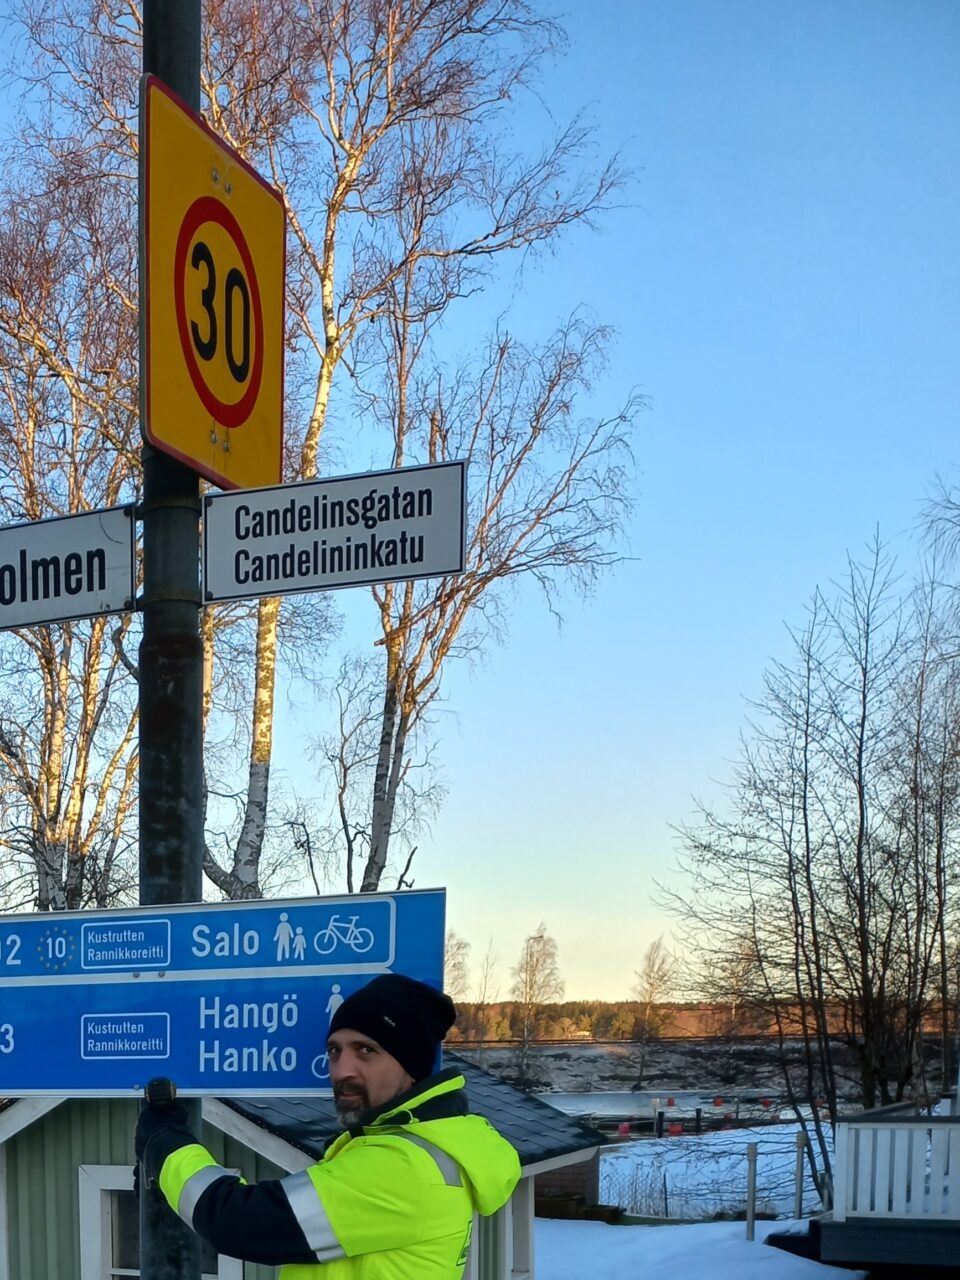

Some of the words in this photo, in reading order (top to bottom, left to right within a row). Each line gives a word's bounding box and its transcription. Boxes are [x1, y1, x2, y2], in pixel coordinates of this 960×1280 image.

[190, 241, 251, 384] 30
[234, 485, 433, 541] Candelinsgatan
[234, 530, 425, 585] Candelininkatu
[46, 937, 67, 959] 10
[87, 930, 145, 944] Kustrutten
[87, 946, 164, 961] Rannikkoreitti
[191, 923, 260, 958] Salo
[87, 1022, 144, 1035] Kustrutten
[199, 994, 299, 1033] Hangö
[87, 1038, 163, 1052] Rannikkoreitti
[199, 1040, 297, 1073] Hanko
